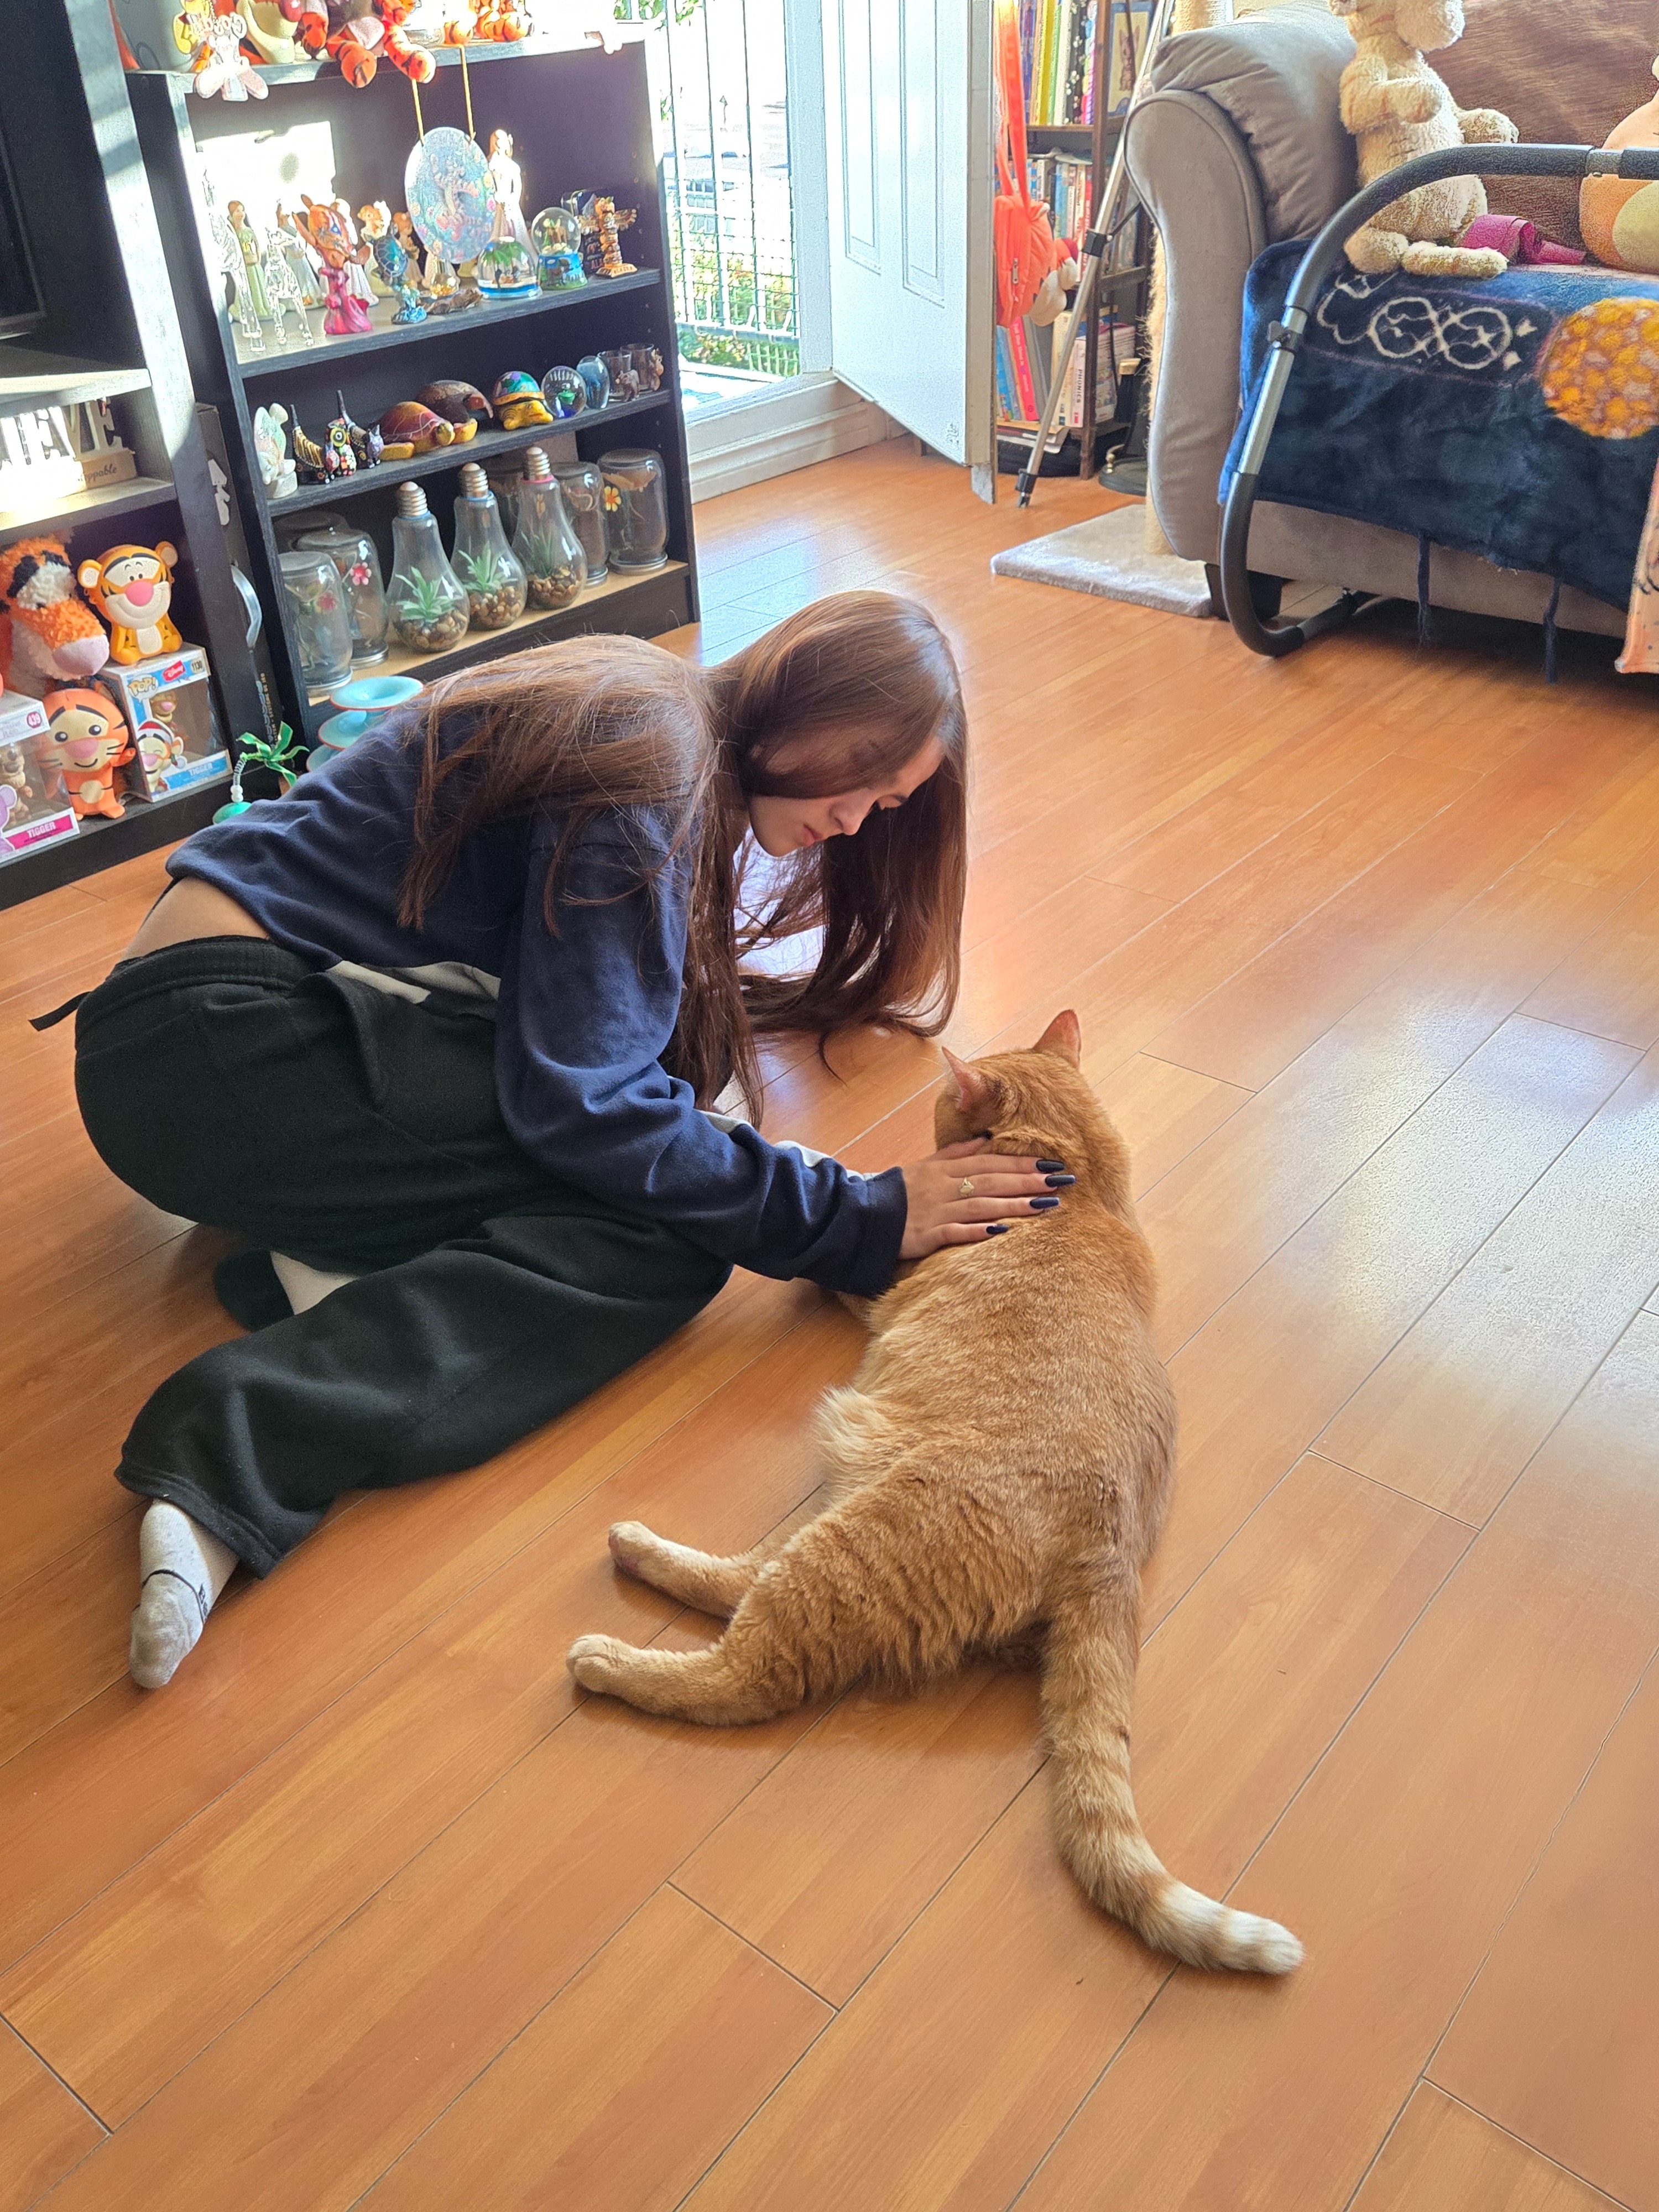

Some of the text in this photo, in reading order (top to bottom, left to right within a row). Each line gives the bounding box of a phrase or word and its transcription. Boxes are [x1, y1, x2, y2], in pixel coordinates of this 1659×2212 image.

[127, 676, 156, 697] POP!
[28, 712, 41, 726] 439
[188, 762, 213, 776] TIGGER
[27, 821, 56, 838] TIGGER
